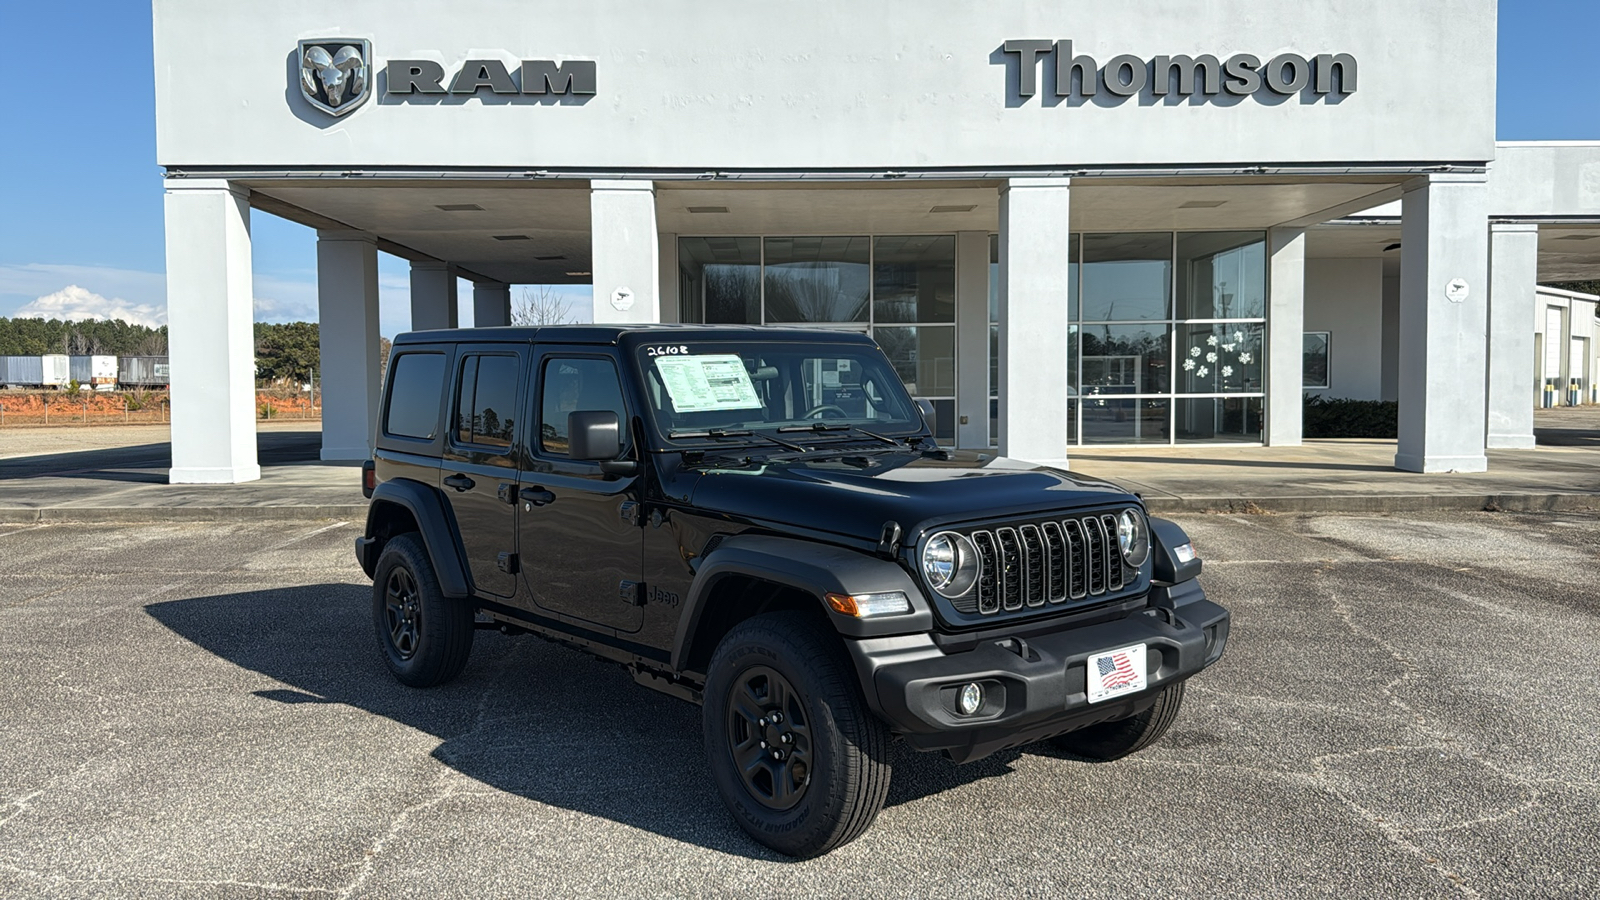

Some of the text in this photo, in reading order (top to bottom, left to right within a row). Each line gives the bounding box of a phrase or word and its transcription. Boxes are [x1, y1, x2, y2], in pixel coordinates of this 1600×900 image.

[386, 59, 597, 94] RAM
[1004, 39, 1357, 96] Thomson
[649, 585, 679, 608] Jeep
[728, 645, 777, 663] NEXEN
